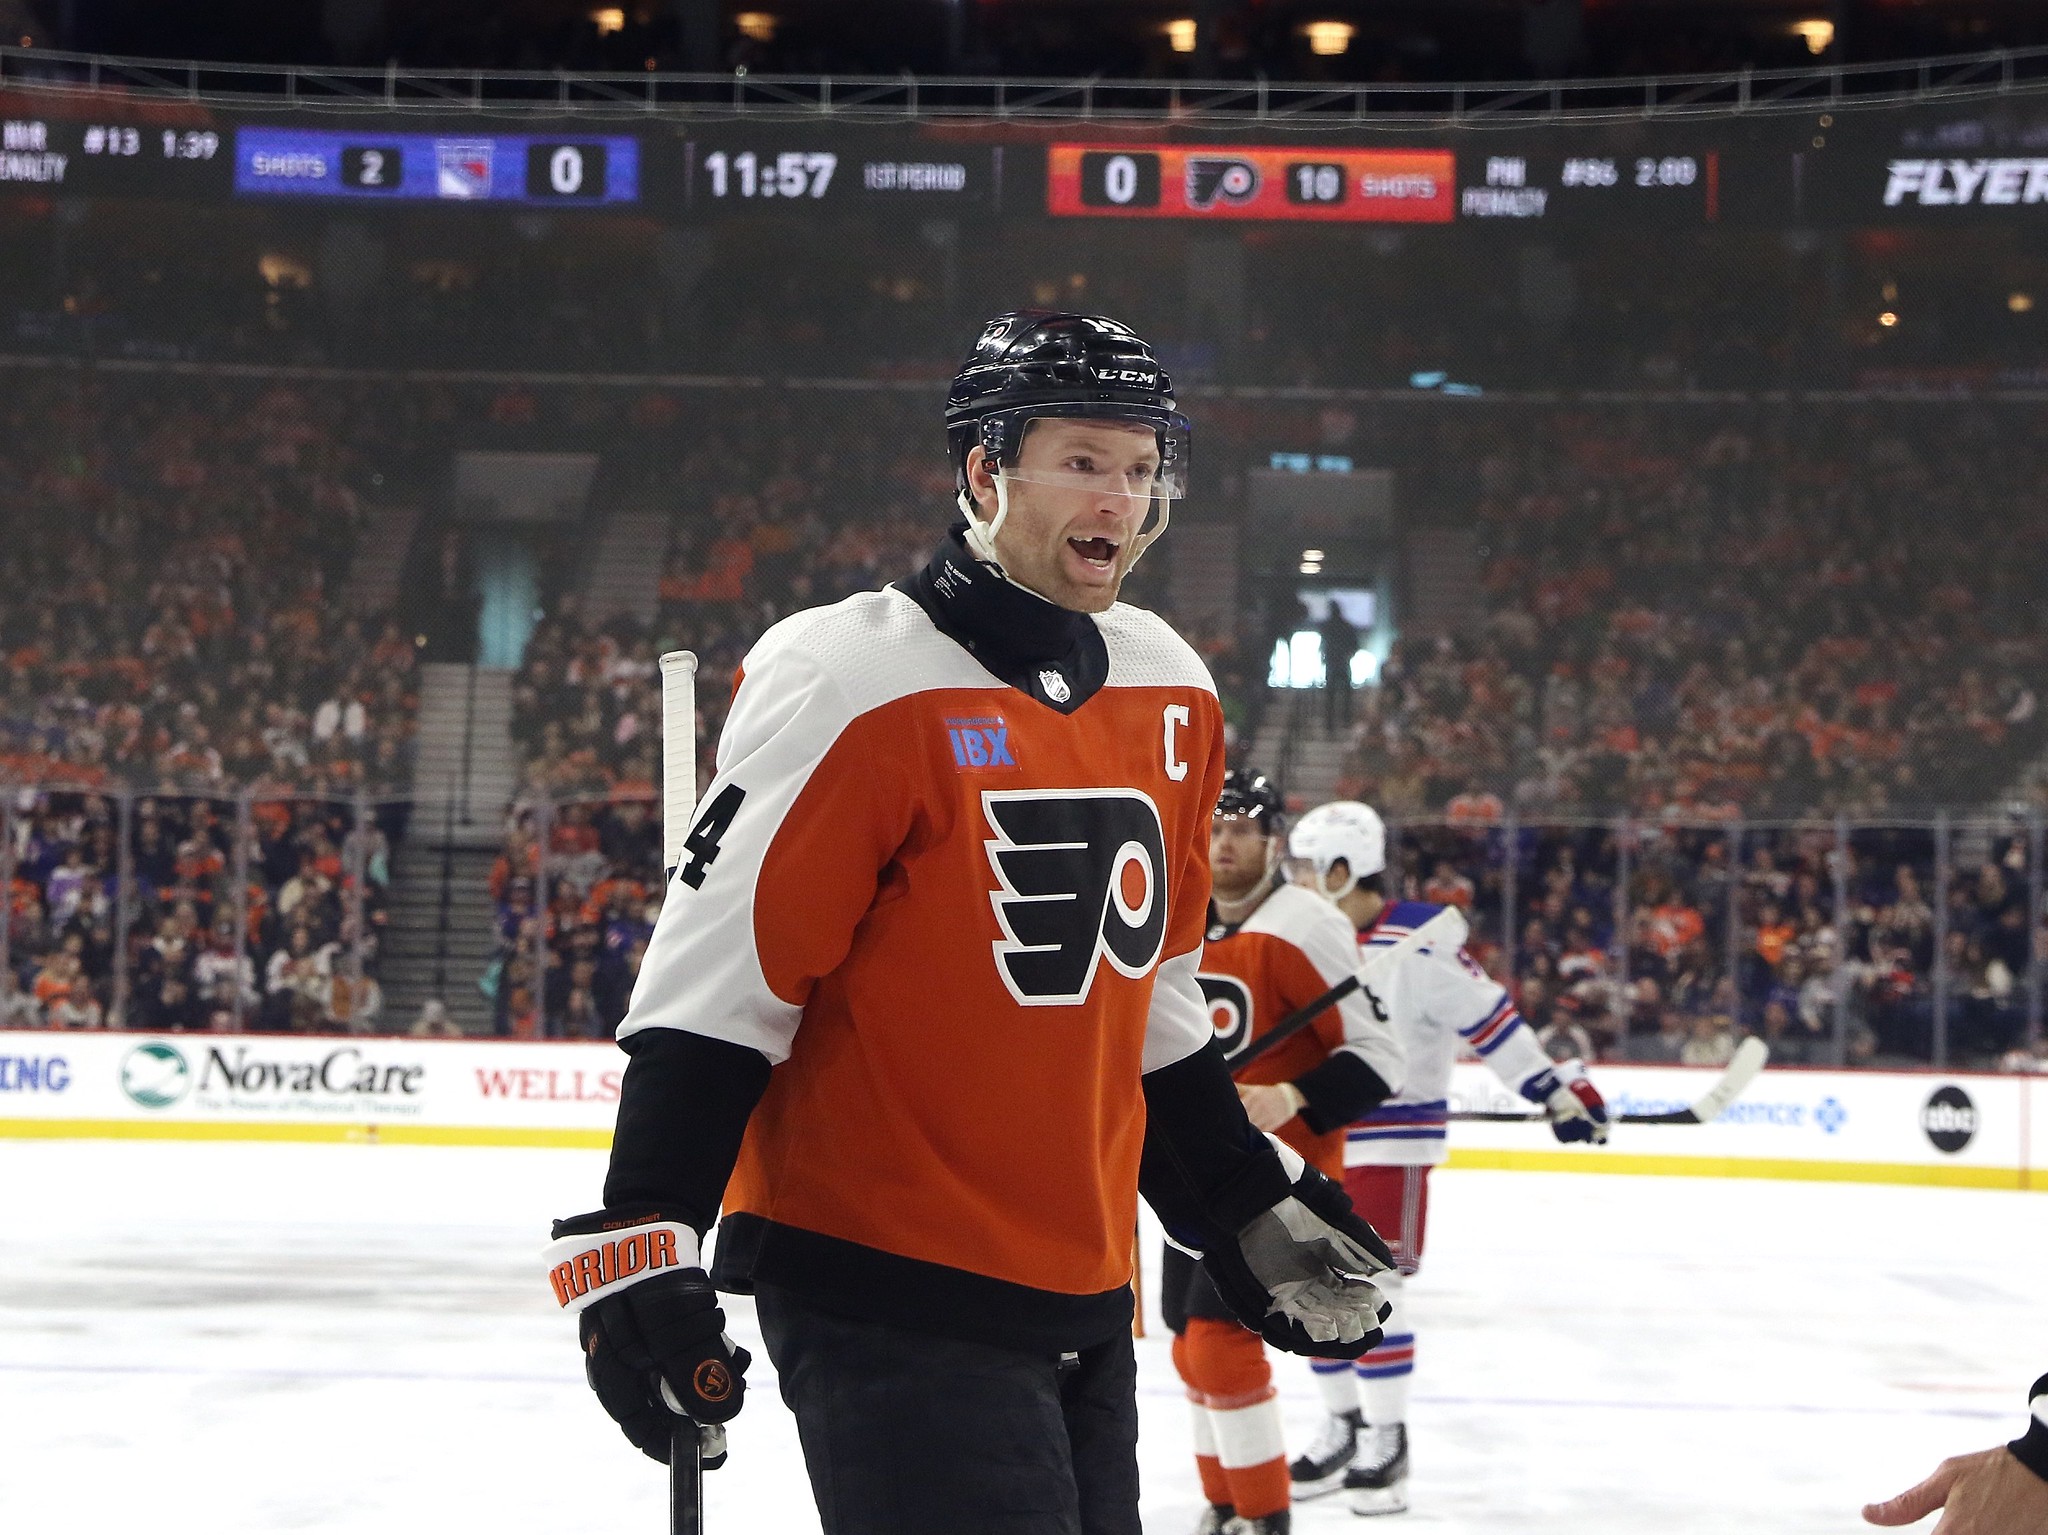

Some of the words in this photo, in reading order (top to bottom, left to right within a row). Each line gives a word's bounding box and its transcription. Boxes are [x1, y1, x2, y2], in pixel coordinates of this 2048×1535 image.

[83, 125, 141, 155] #13
[252, 150, 327, 179] SHOTS
[358, 149, 384, 185] 2
[549, 145, 583, 194] 0
[704, 151, 837, 198] 11:57
[1104, 155, 1138, 204] 0
[1296, 165, 1341, 201] 10
[1361, 172, 1438, 199] SHOTS
[948, 727, 1017, 767] IBX
[1163, 703, 1190, 782] C
[680, 783, 747, 891] 4
[0, 1056, 70, 1092] ING
[200, 1046, 424, 1096] NovaCare
[475, 1066, 621, 1102] WELLS
[1926, 1101, 1975, 1133] abc
